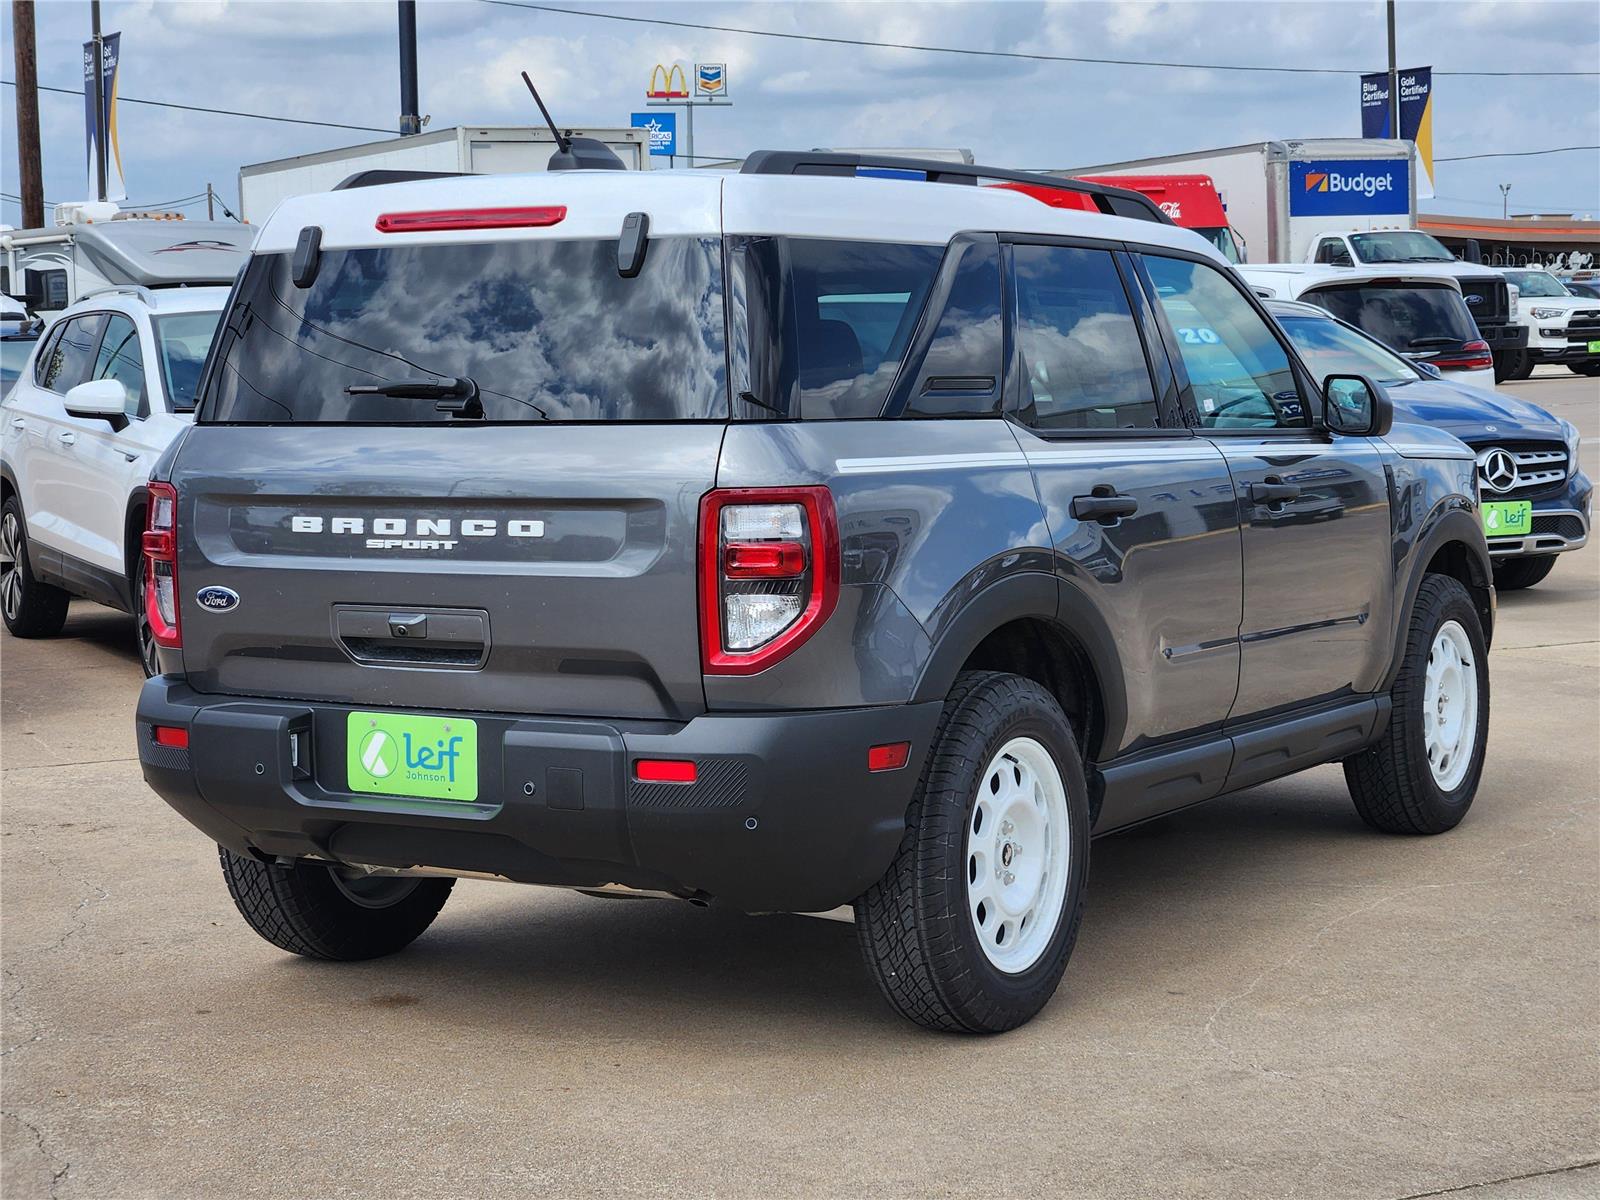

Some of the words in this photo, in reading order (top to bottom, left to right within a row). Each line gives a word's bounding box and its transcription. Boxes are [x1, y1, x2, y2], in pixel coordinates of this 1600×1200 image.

[1363, 83, 1378, 92] Blue
[1401, 77, 1415, 87] Gold
[1363, 90, 1389, 101] Certified
[1401, 84, 1428, 96] Certified
[1330, 173, 1392, 197] Budget
[1179, 328, 1217, 343] 20
[292, 516, 545, 537] BRONCO
[366, 539, 458, 550] SPORT
[403, 733, 463, 782] leif
[406, 771, 446, 782] Johnson
